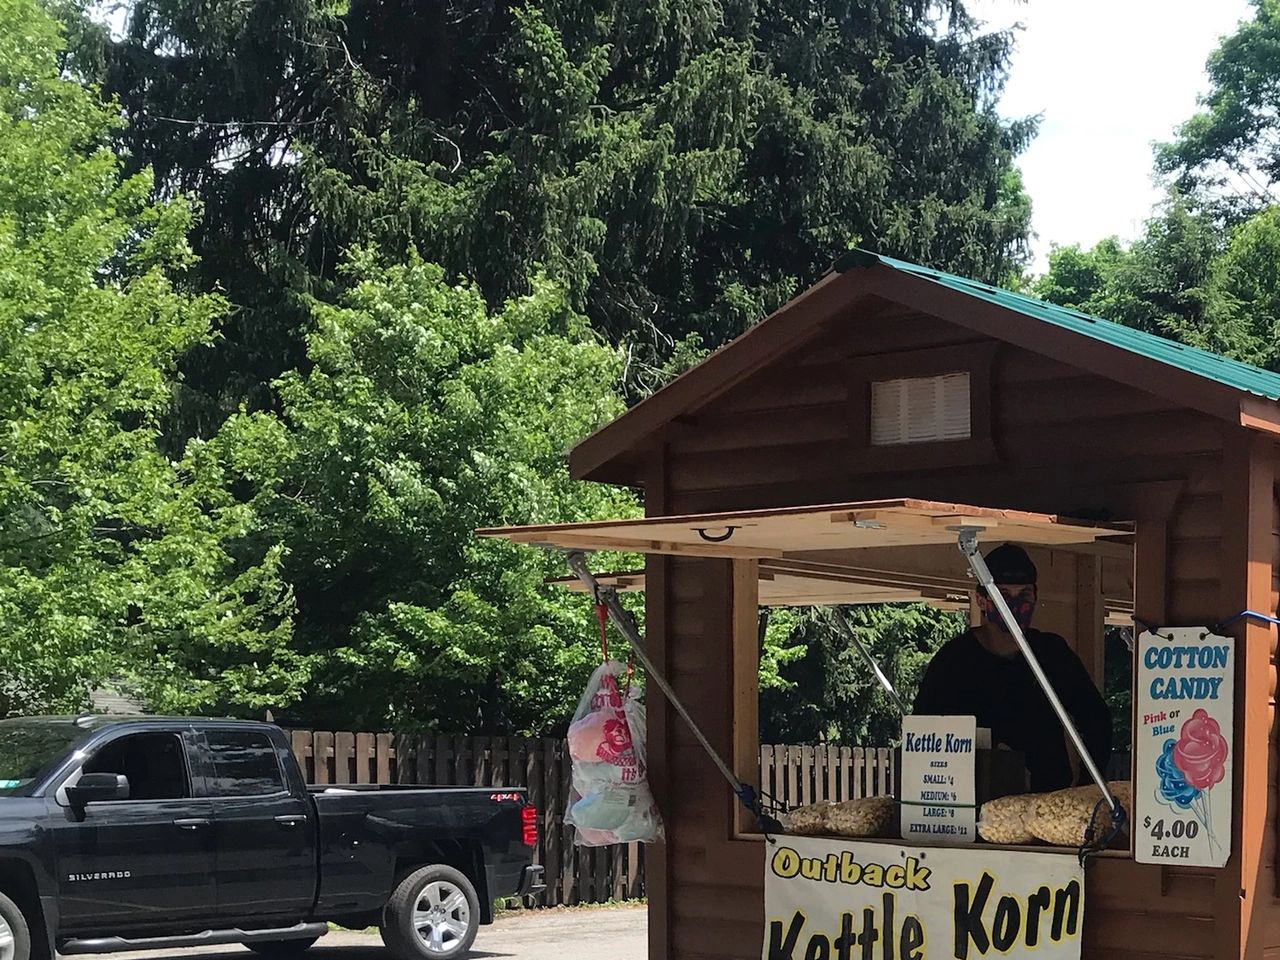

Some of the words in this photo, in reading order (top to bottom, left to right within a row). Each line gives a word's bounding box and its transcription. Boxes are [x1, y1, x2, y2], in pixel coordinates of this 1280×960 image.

[1144, 646, 1229, 670] COTTON
[1150, 677, 1223, 700] CANDY
[1143, 712, 1167, 725] Pink
[1169, 709, 1181, 719] or
[1152, 725, 1176, 737] Blue
[905, 732, 942, 753] Kettle
[944, 733, 972, 753] Korn
[923, 807, 947, 818] LARGE:
[909, 823, 931, 834] EXTRA
[1143, 815, 1199, 841] $4.00
[1151, 845, 1190, 859] EACH
[68, 870, 131, 881] SILVERADO
[772, 846, 931, 891] Outback
[952, 870, 1081, 960] Korn
